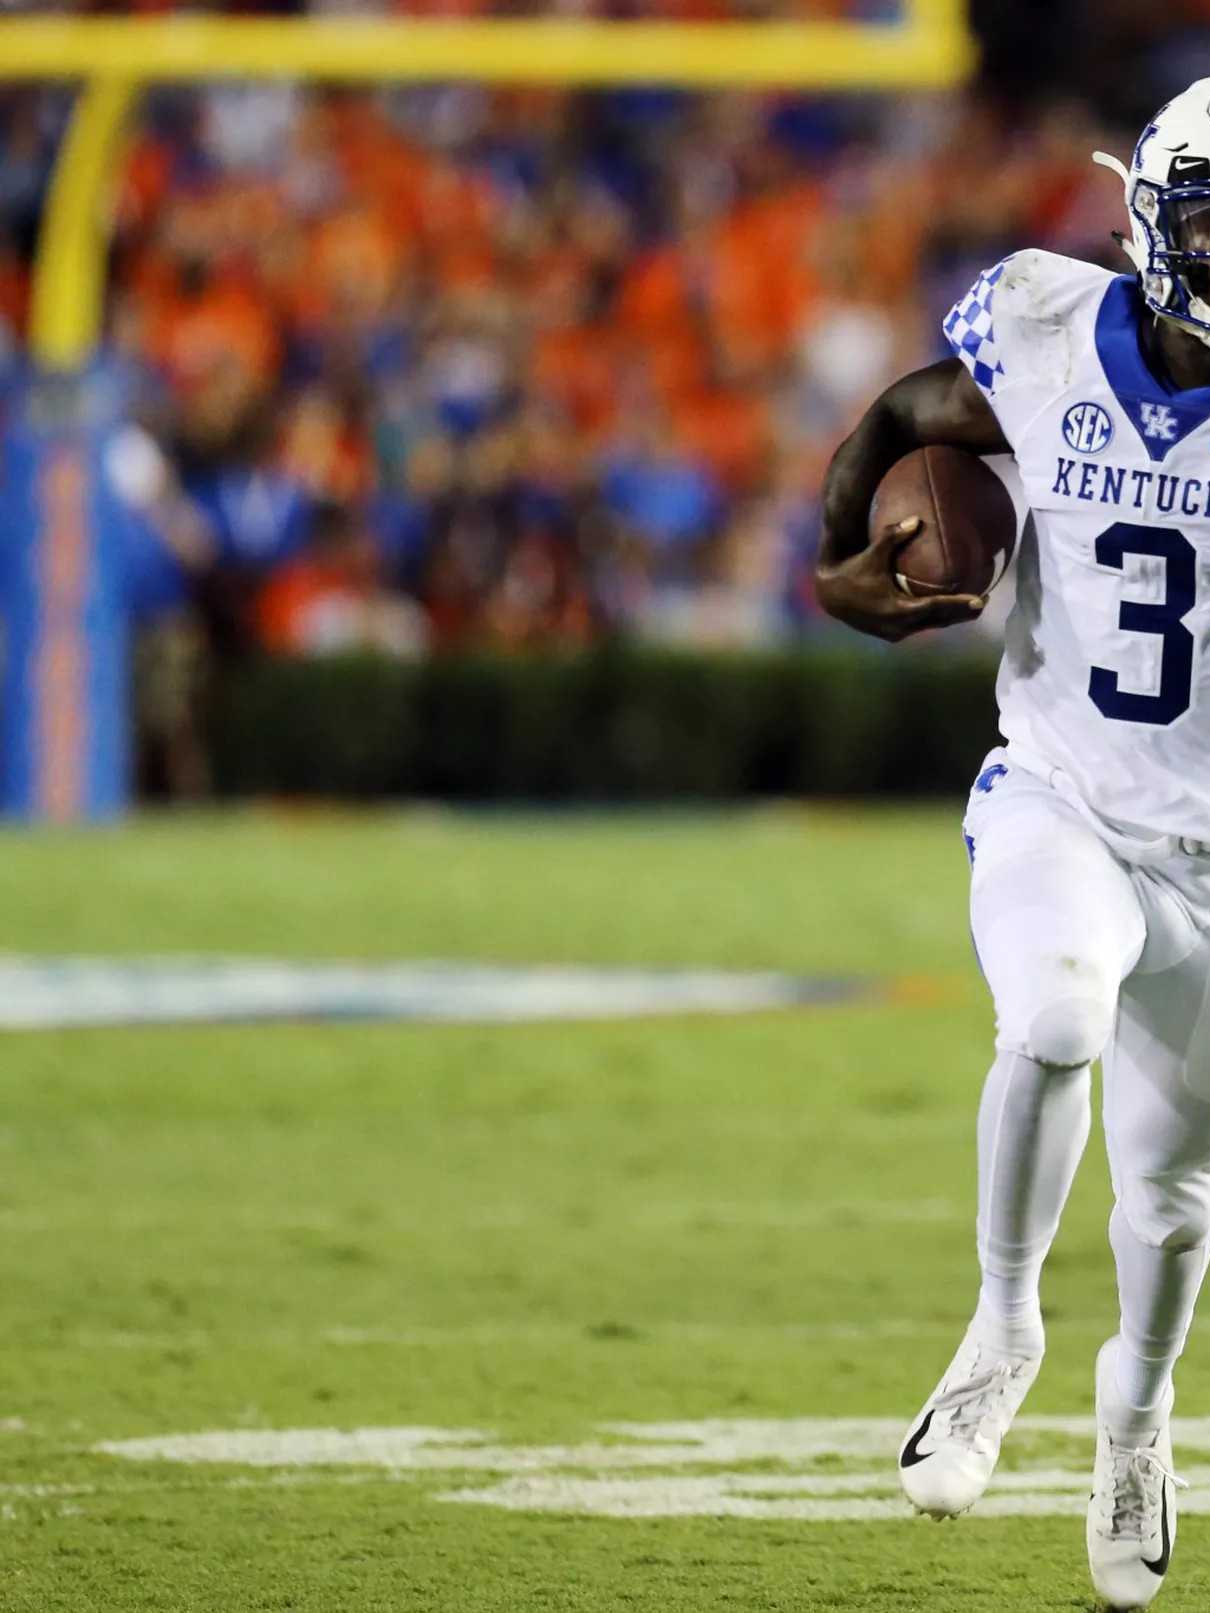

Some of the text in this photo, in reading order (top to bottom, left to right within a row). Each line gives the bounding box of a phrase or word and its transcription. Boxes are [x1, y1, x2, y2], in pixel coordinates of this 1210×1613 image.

[1065, 403, 1111, 452] SEC
[1140, 402, 1178, 440] UK
[1088, 521, 1197, 726] 3
